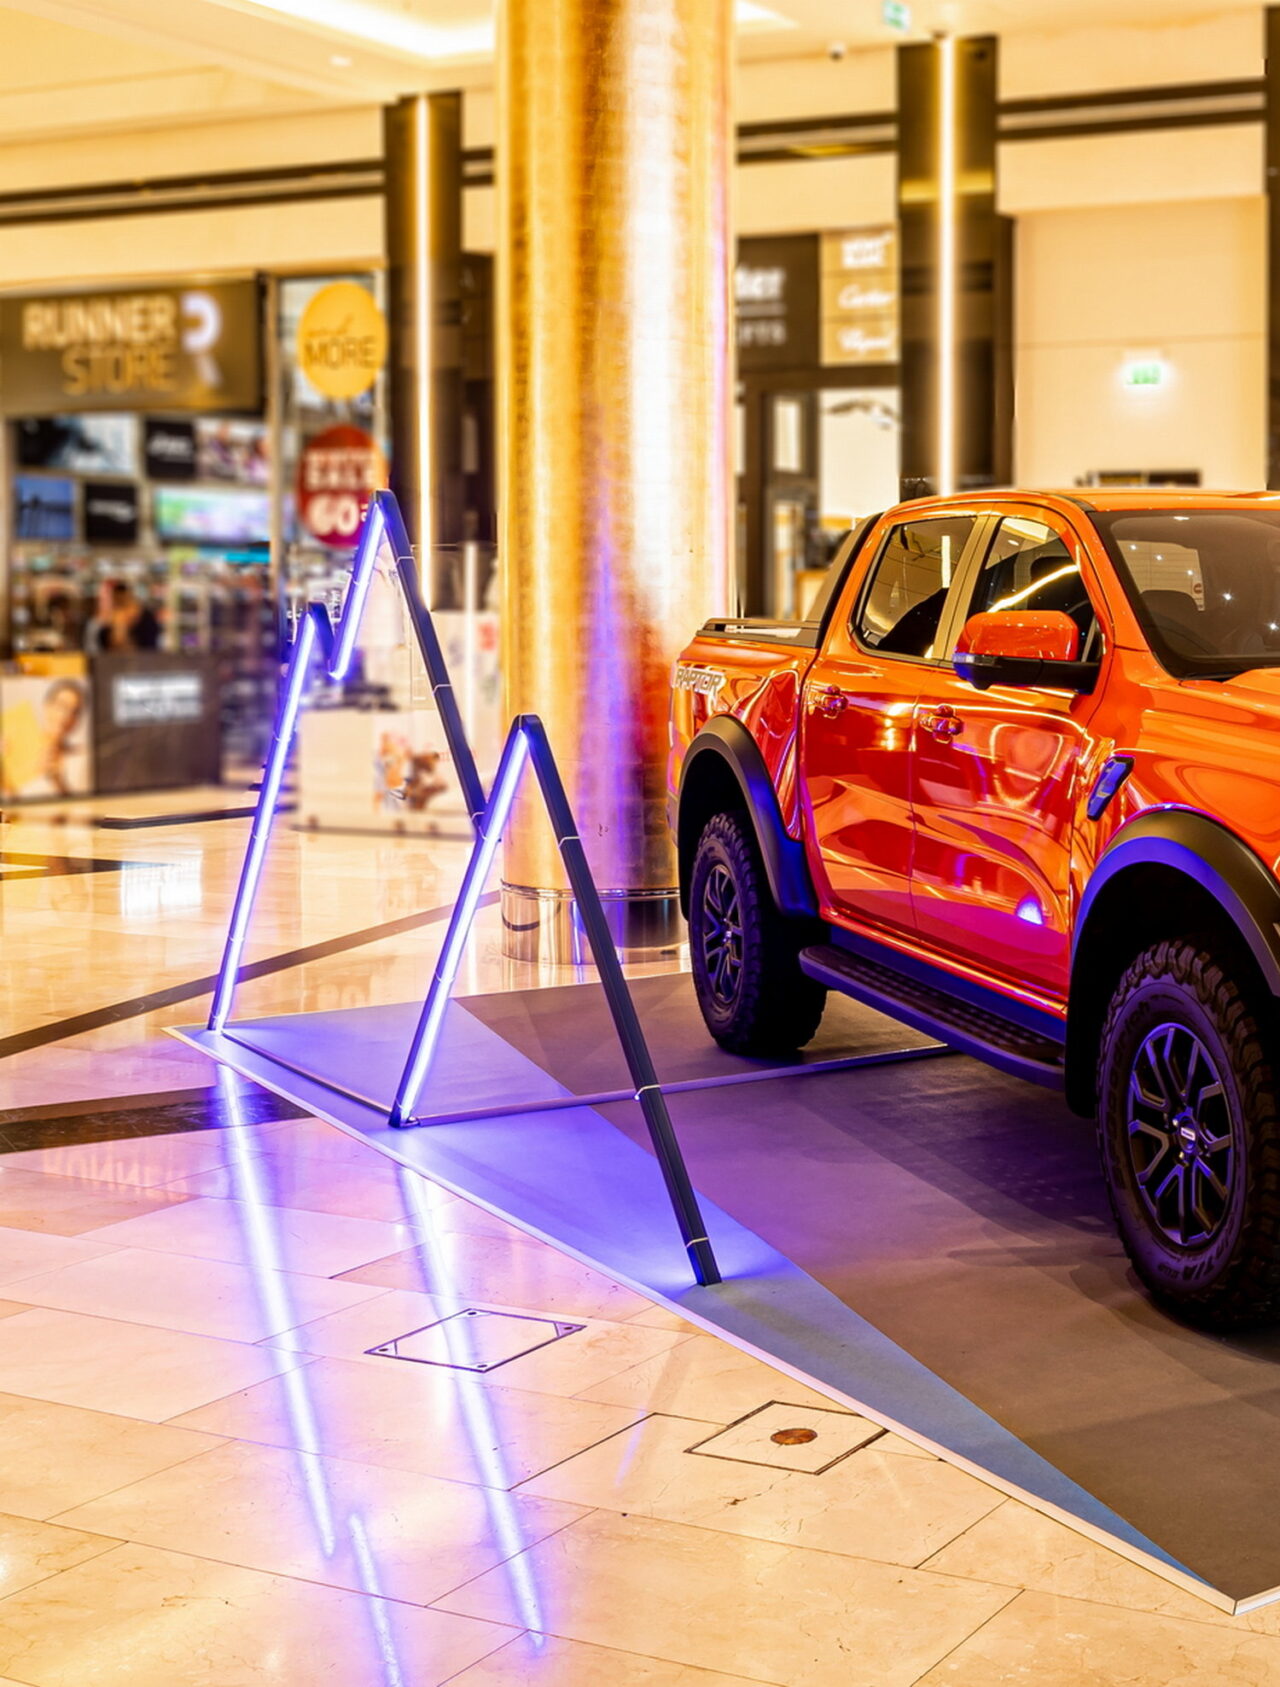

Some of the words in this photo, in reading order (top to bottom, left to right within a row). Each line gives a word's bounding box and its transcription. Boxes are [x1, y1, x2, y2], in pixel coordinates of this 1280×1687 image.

[22, 295, 176, 349] RUNNER
[63, 347, 176, 395] STORE
[304, 336, 377, 371] MORE
[675, 668, 722, 696] RAPTOR
